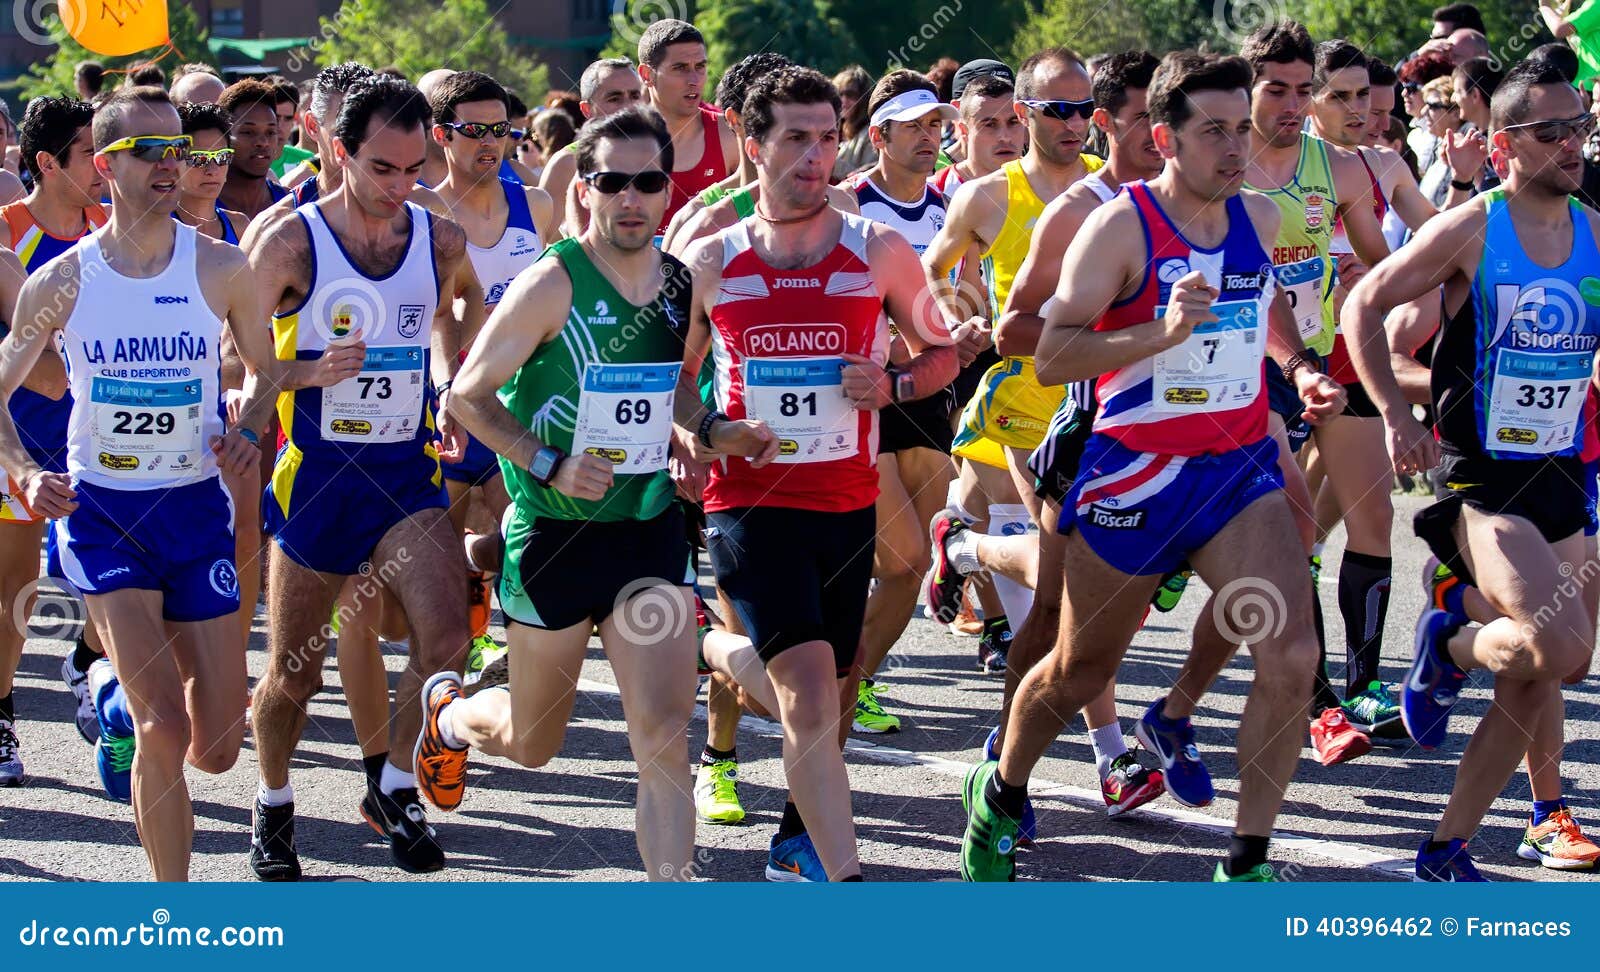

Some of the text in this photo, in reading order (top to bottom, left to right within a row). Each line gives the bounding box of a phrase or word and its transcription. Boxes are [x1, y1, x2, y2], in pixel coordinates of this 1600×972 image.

[1273, 244, 1317, 264] RENEDO
[587, 316, 617, 325] VIATOR
[83, 331, 207, 364] LA ARMUÑA
[750, 331, 840, 353] POLANCO
[1203, 339, 1220, 364] 7
[101, 367, 191, 378] CLUB DEPORTIVO
[357, 377, 392, 400] 73
[1516, 384, 1571, 409] 337
[615, 399, 651, 425] 69
[780, 392, 817, 416] 81
[112, 411, 175, 435] 229
[1091, 507, 1143, 527] Toscaf
